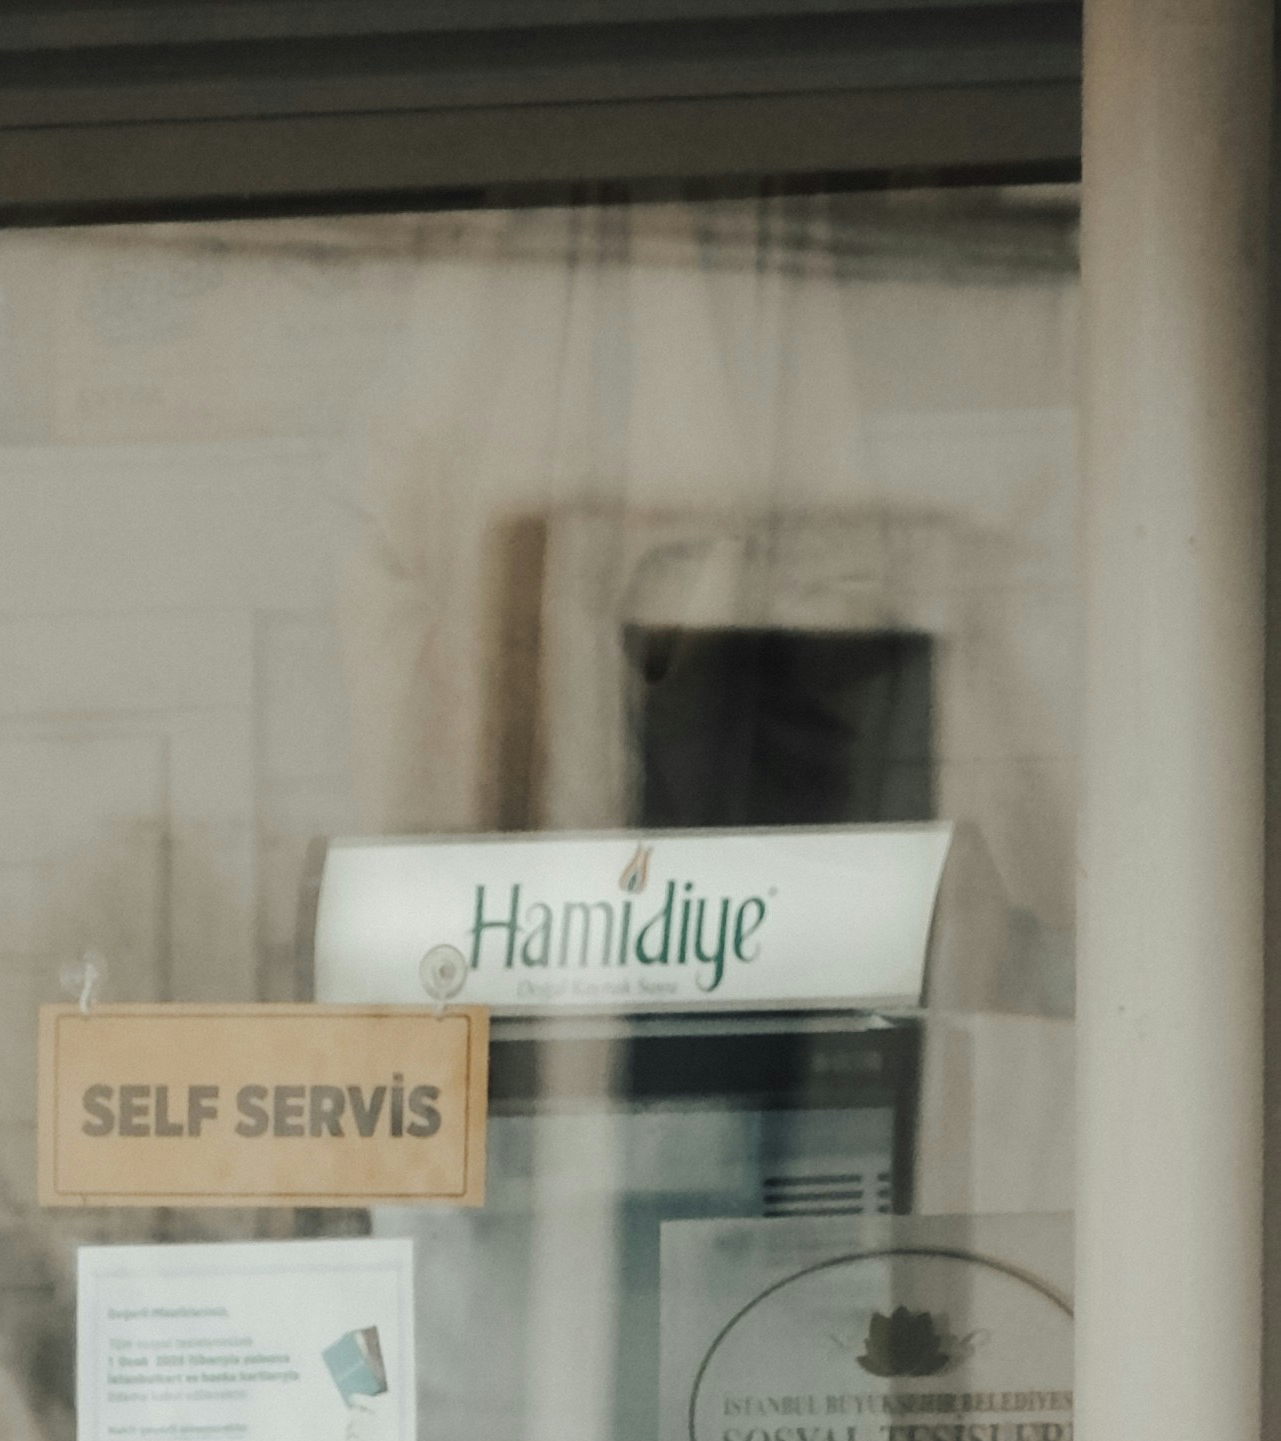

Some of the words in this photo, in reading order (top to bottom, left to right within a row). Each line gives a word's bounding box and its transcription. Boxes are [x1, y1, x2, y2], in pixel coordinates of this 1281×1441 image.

[469, 878, 767, 992] Hamidiye
[81, 1083, 220, 1138] SELF
[235, 1071, 442, 1138] SERVİS
